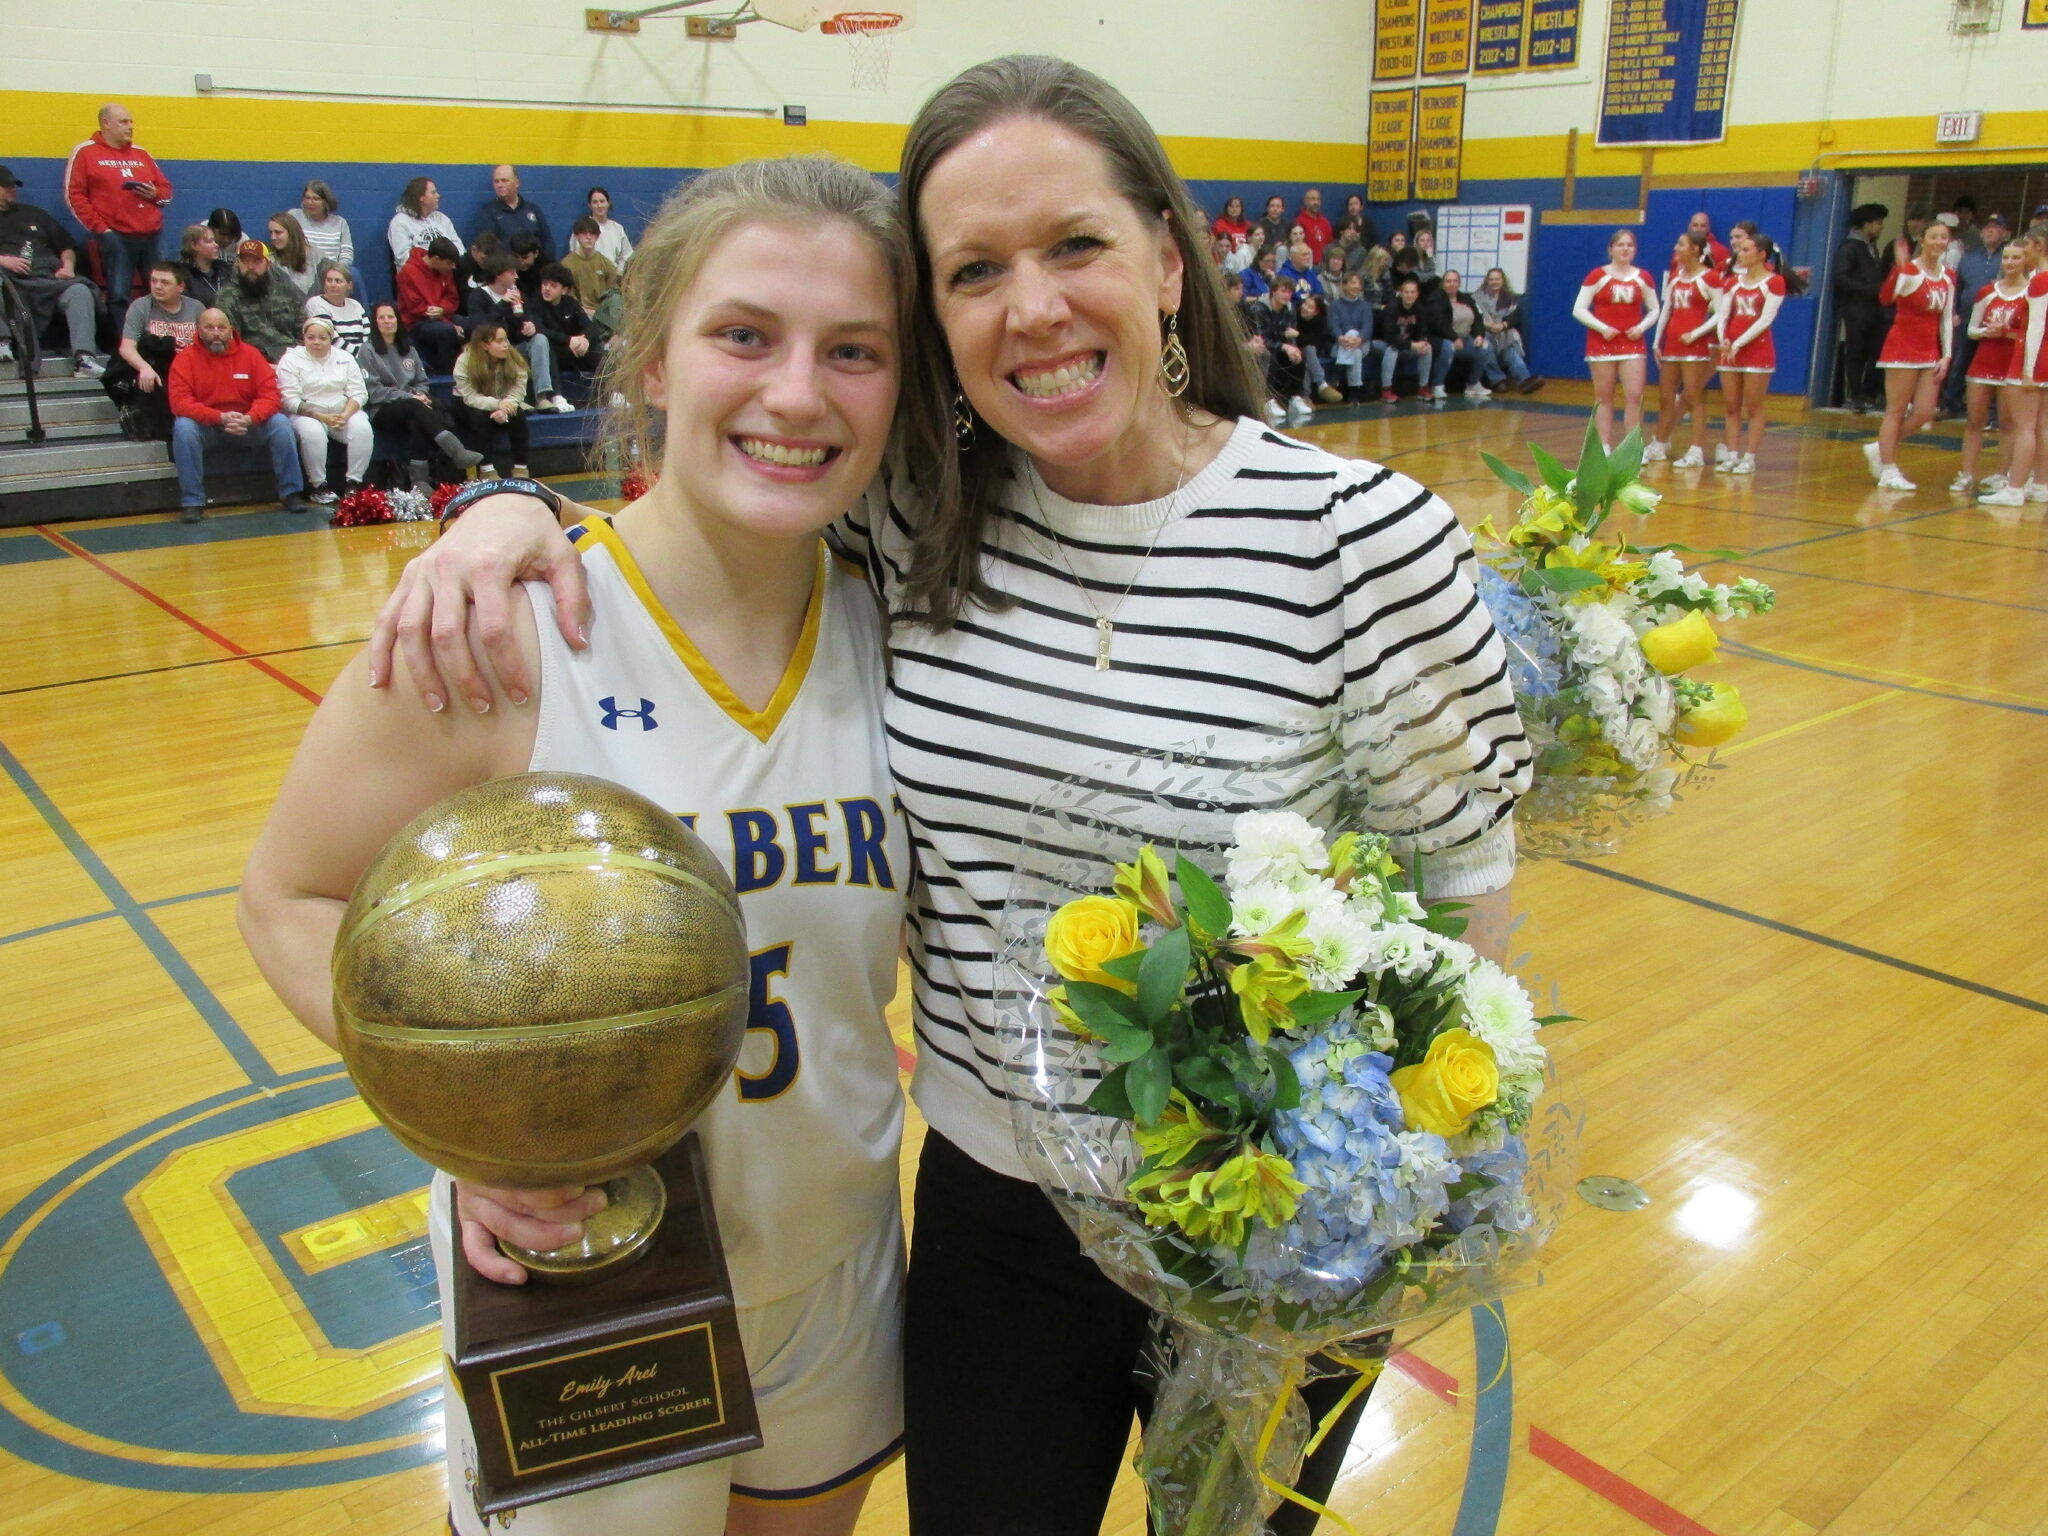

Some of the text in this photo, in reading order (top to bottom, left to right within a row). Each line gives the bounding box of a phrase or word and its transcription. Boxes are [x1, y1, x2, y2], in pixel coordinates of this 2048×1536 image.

[1480, 2, 1522, 20] CHAMPIONS
[1533, 9, 1577, 31] WRESTLING
[1380, 34, 1415, 50] WRESTLING
[1430, 29, 1465, 45] WRESTLING
[1479, 24, 1520, 42] WRESTLING
[1943, 116, 1970, 138] EXIT
[121, 168, 134, 178] N
[1611, 284, 1636, 304] N
[1673, 288, 1694, 309] N
[1929, 290, 1948, 311] N
[1736, 293, 1760, 317] N
[480, 481, 499, 491] for
[502, 479, 528, 491] Pray
[733, 941, 802, 1103] 5
[560, 1375, 613, 1402] Emily
[536, 1386, 690, 1430] THE GILBERT SCHOOL
[519, 1397, 713, 1451] ALL-TIME LEADING SCORER
